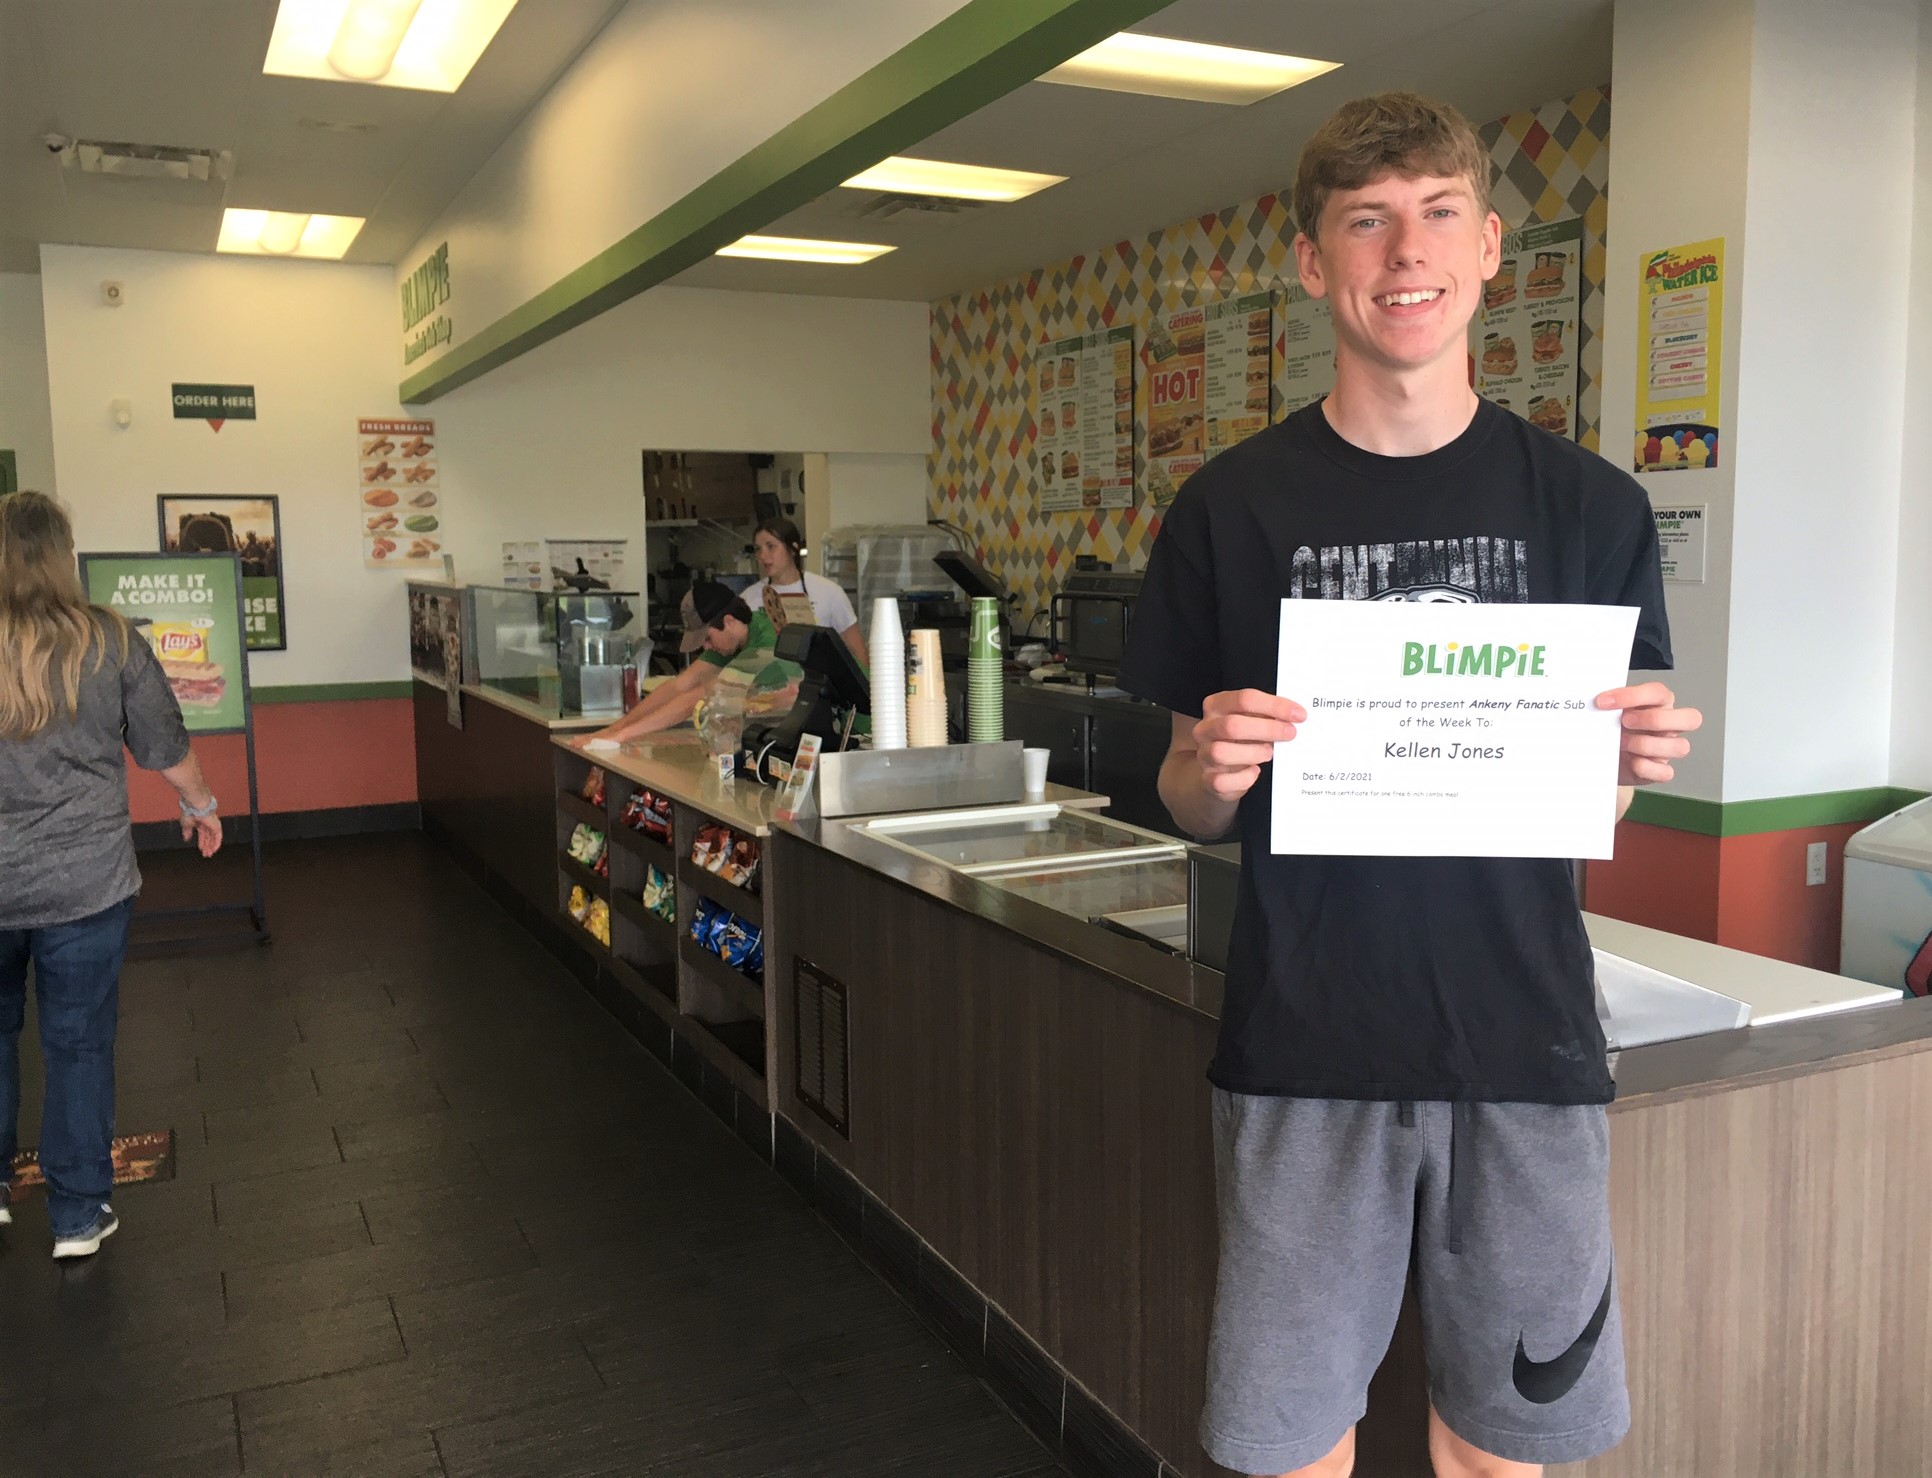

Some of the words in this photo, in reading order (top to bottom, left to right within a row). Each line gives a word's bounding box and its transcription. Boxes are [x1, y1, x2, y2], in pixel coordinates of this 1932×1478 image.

[1663, 268, 1698, 291] WATER
[1700, 264, 1719, 284] ICE
[401, 241, 450, 333] BLIMPIE
[1168, 314, 1204, 331] CATERING
[1152, 367, 1201, 407] HOT
[174, 394, 218, 408] ORDER
[222, 396, 254, 408] HERE
[361, 422, 392, 432] FRESH
[393, 423, 432, 433] BREADS
[1653, 511, 1677, 519] YOUR
[1679, 510, 1701, 519] OWN
[1656, 521, 1681, 529] IMPIE
[118, 574, 180, 590] MAKE
[187, 574, 206, 588] IT
[111, 590, 126, 605] A
[128, 588, 214, 604] COMBO!
[244, 597, 278, 614] ISE
[1312, 697, 1353, 711] Blimpie
[1356, 698, 1366, 709] is
[1369, 698, 1402, 711] proud
[1405, 699, 1418, 709] to
[1420, 700, 1466, 711] present
[1468, 699, 1512, 712] Ankeny
[1516, 699, 1560, 710] Fanatic
[1563, 699, 1586, 710] Sub
[1399, 716, 1413, 727] of
[1416, 717, 1435, 728] the
[1439, 717, 1472, 728] Week
[1476, 717, 1494, 728] To:
[1384, 741, 1441, 759] Kellen
[1447, 742, 1505, 760] Jones
[1302, 772, 1326, 781] Date:
[1328, 772, 1373, 781] 6/2/2021
